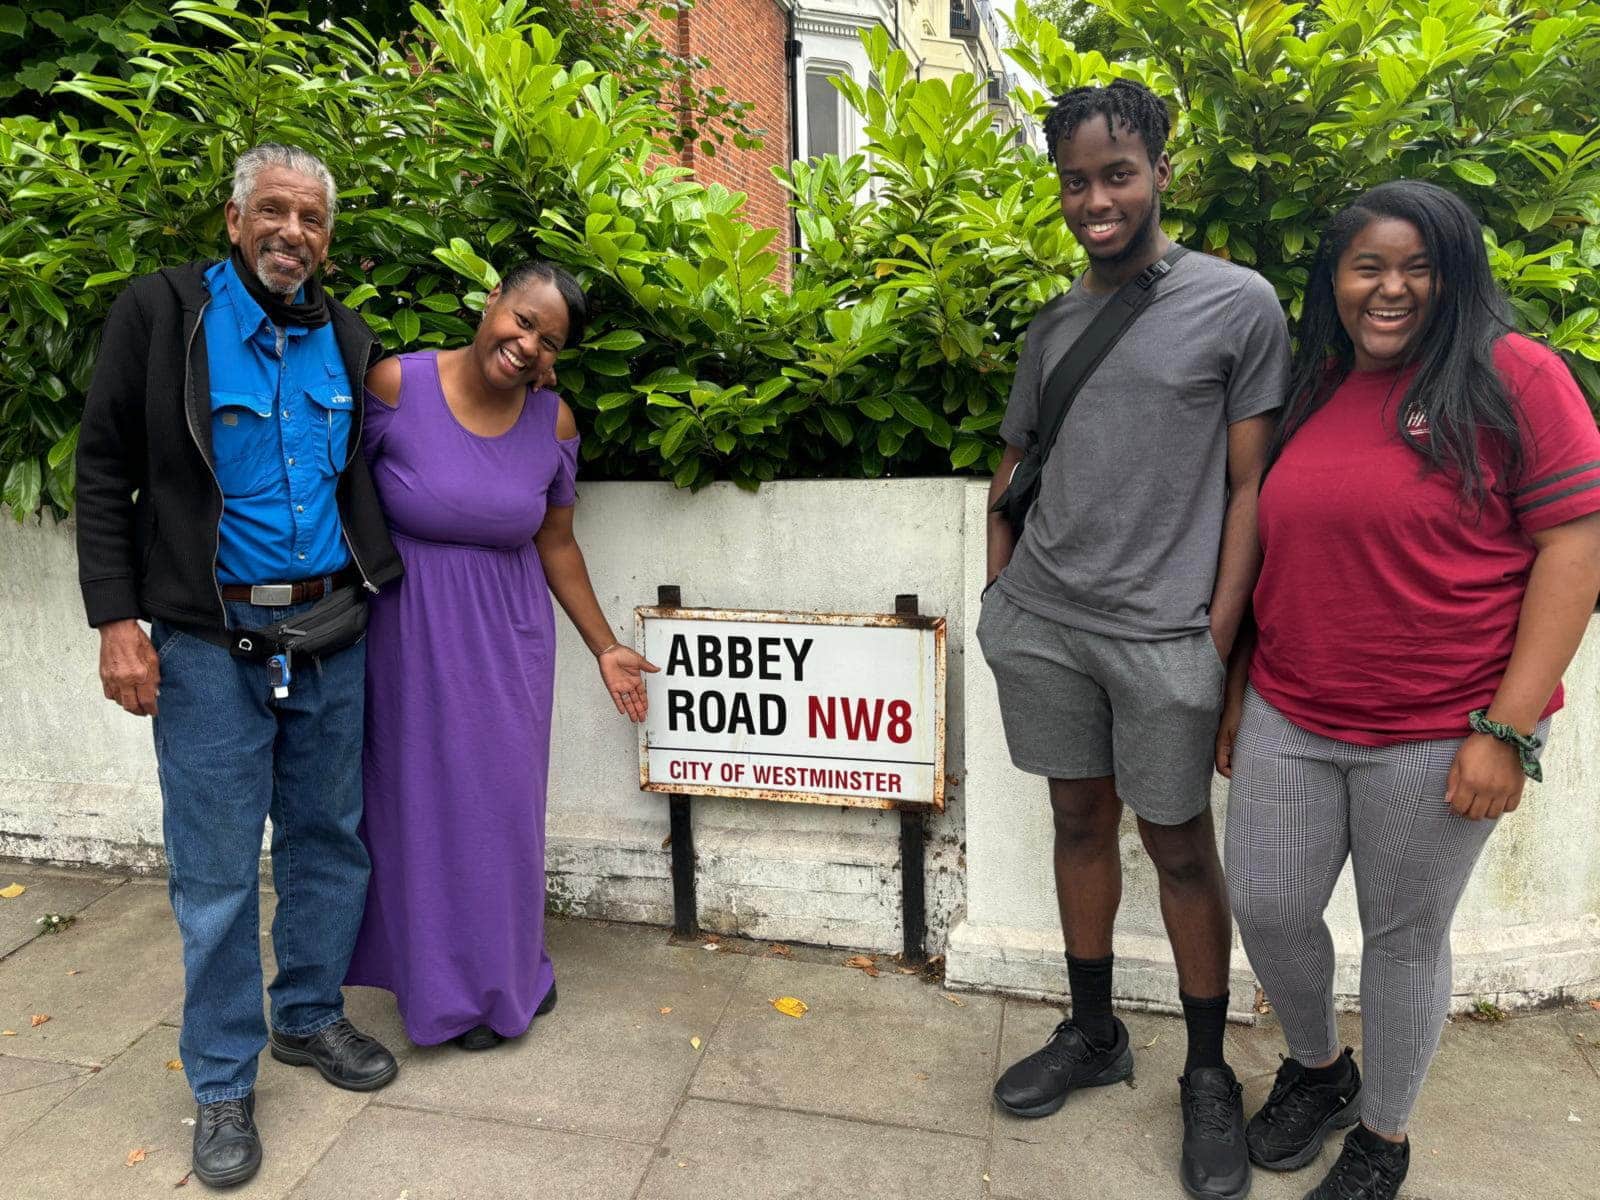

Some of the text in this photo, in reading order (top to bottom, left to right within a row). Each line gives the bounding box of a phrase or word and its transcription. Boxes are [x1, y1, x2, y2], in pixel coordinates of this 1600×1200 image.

[666, 634, 814, 682] ABBEY
[668, 689, 913, 744] ROAD NW8
[669, 760, 902, 793] CITY OF WESTMINSTER
